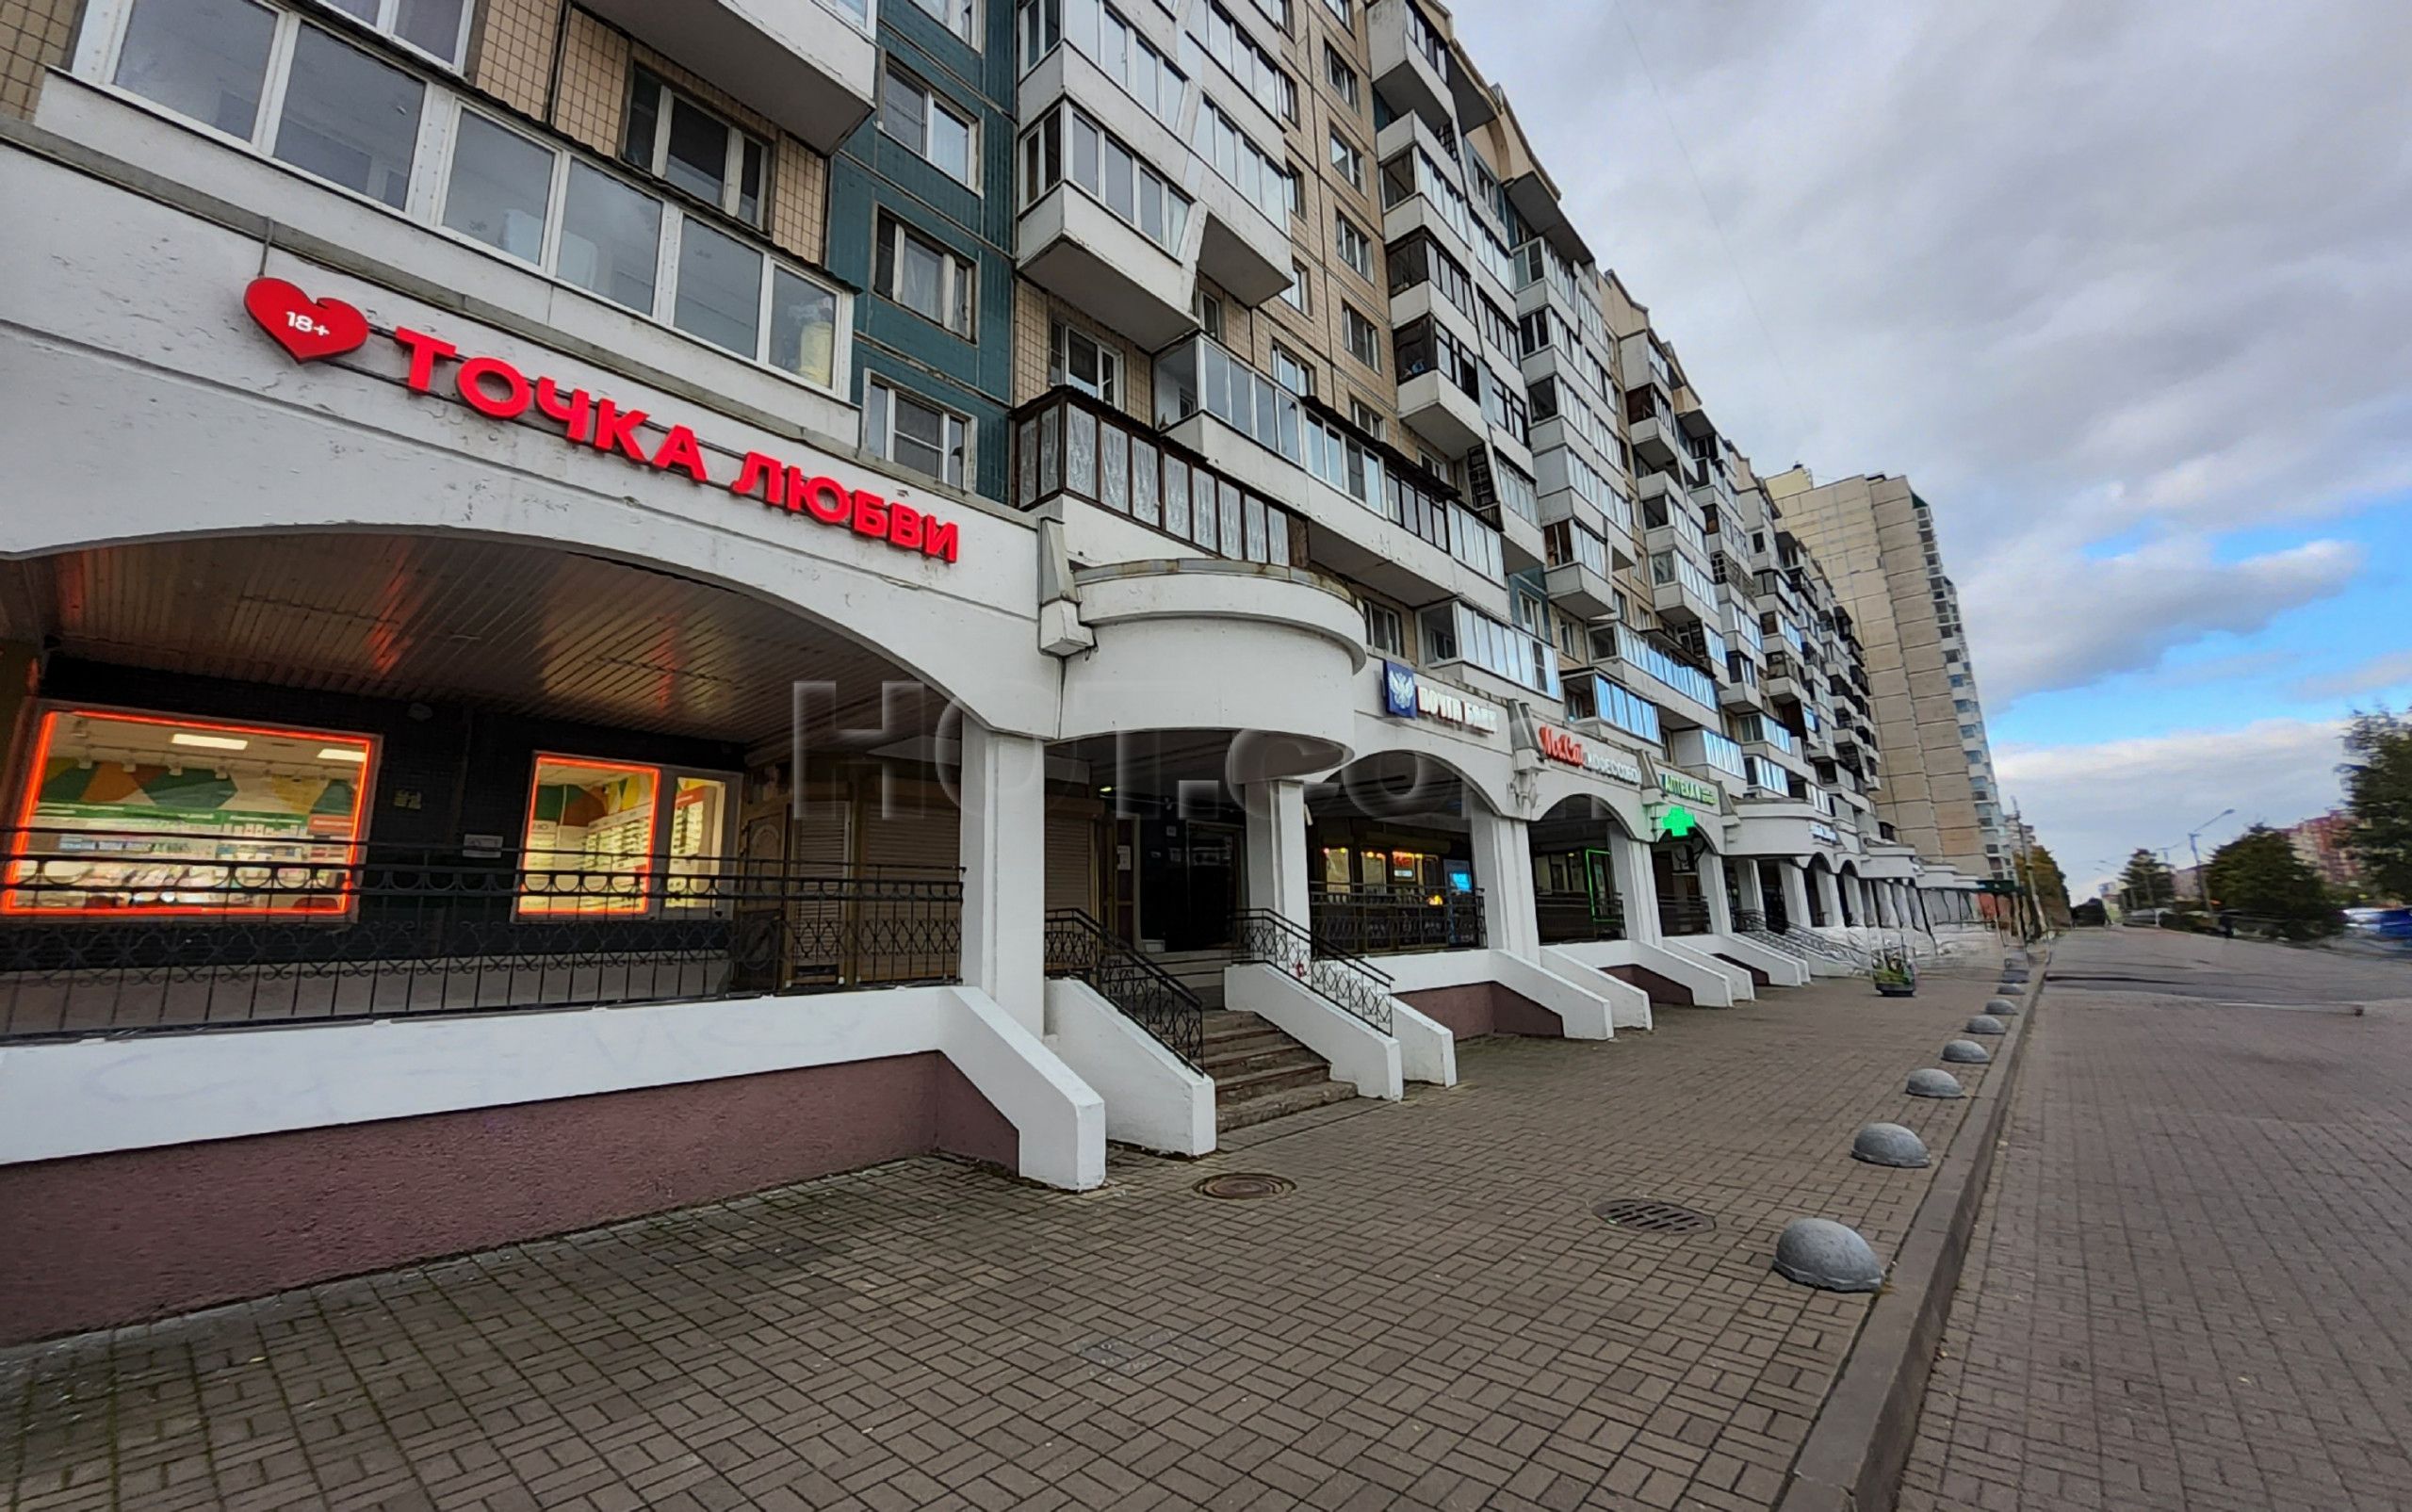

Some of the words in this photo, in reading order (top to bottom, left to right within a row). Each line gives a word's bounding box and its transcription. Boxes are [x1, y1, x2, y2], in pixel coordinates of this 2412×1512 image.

[285, 311, 330, 336] 18+
[395, 327, 708, 481] ТОЧКА
[732, 452, 959, 563] ЛЮБВИ
[1665, 772, 1697, 800] АПТЕКА
